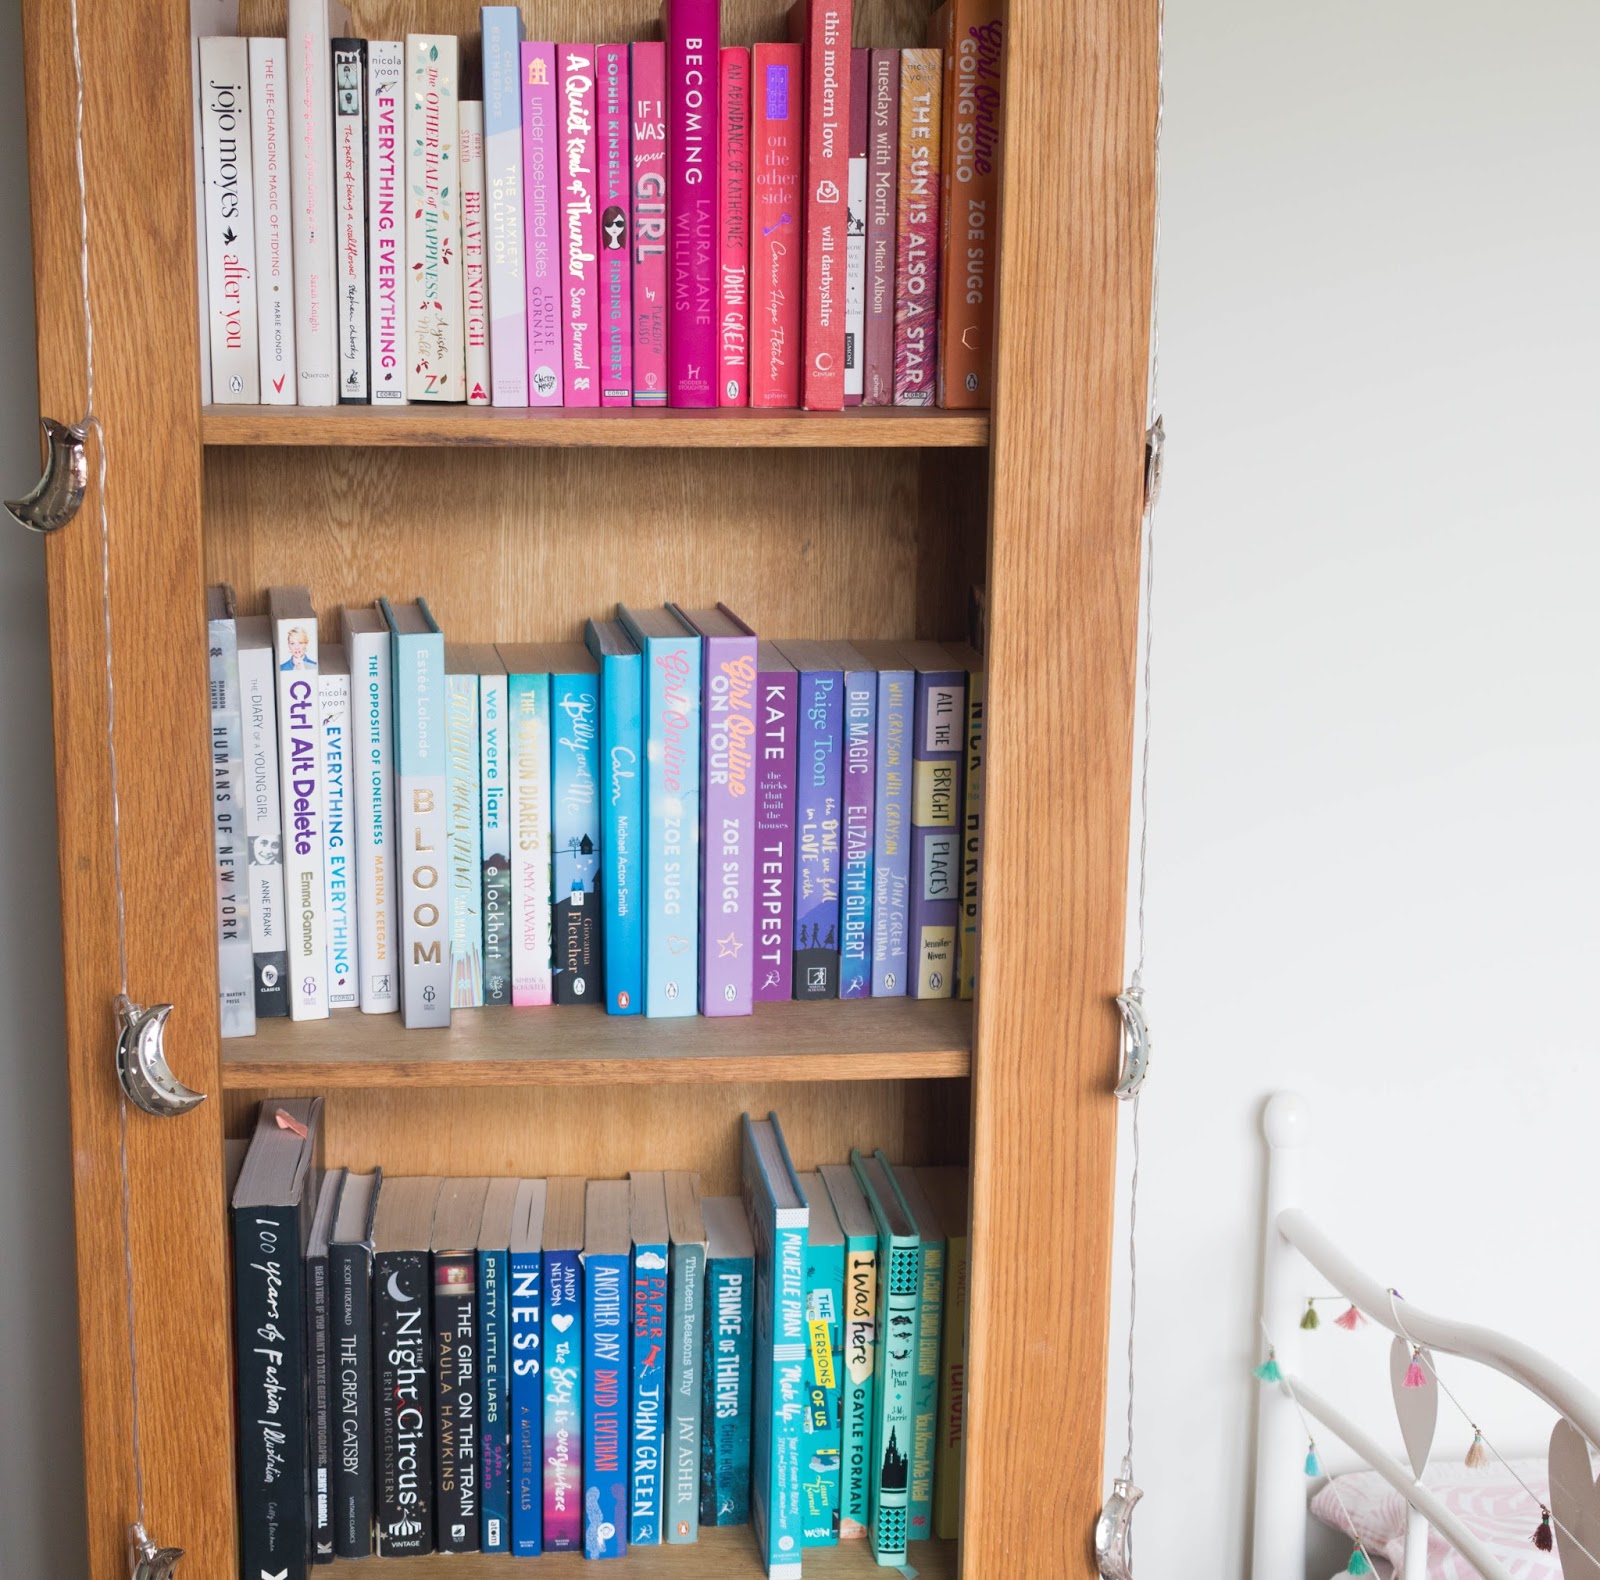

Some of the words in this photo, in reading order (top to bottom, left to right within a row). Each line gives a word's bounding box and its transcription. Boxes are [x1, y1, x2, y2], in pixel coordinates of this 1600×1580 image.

[824, 11, 839, 46] this
[265, 58, 273, 80] THE
[372, 55, 401, 65] nicola
[375, 68, 399, 77] yoon
[428, 67, 438, 87] The
[608, 53, 619, 114] SOPHIE
[823, 50, 837, 118] modern
[958, 39, 976, 118] GOING
[210, 80, 241, 131] jojo
[686, 38, 702, 185] BECOMING
[875, 61, 892, 126] tuesdays
[911, 92, 930, 138] THE
[266, 83, 275, 171] LIFE-CHANGING
[426, 92, 439, 148] OTHER
[531, 97, 545, 145] under
[823, 122, 838, 158] love
[379, 97, 394, 231] EVERYTHING,
[426, 152, 439, 196] HALF
[608, 121, 619, 199] KINSELLA
[876, 133, 890, 165] with
[910, 147, 928, 195] SUN
[957, 123, 974, 182] SOLO
[214, 138, 240, 218] moyes
[268, 174, 277, 211] MAGIC
[426, 196, 437, 208] of
[532, 147, 546, 238] rose-tainted
[875, 172, 890, 225] Morrie
[270, 214, 278, 229] OF
[465, 191, 482, 256] BRAVE
[696, 200, 710, 267] LAURA
[821, 226, 834, 251] will
[910, 203, 926, 223] IS
[968, 200, 985, 240] ZOE
[271, 232, 280, 276] TIDYING
[425, 211, 439, 298] HAPPINESS
[535, 241, 548, 277] skies
[675, 213, 690, 311] WILLIAMS
[875, 240, 886, 272] Mitch
[907, 233, 926, 293] ALSO
[967, 248, 983, 304] SUGG
[223, 254, 250, 306] after
[380, 239, 396, 369] EVERYTHING
[467, 264, 484, 347] ENOUGH
[611, 260, 620, 319] FINDING
[696, 274, 710, 325] JANE
[723, 264, 746, 304] JOHN
[819, 254, 834, 326] darbyshire
[874, 276, 886, 313] Albom
[217, 310, 243, 349] you
[274, 301, 282, 327] MARIE
[533, 287, 544, 354] GORNALL
[544, 295, 554, 345] LOUISE
[907, 302, 923, 317] A
[275, 330, 283, 362] KONDO
[611, 326, 622, 380] AUDREY
[723, 312, 744, 365] GREEN
[905, 327, 924, 383] STAR
[368, 655, 378, 677] THE
[289, 681, 313, 729] Ctrl
[369, 683, 380, 744] OPPOSITE
[486, 690, 499, 720] we
[711, 675, 728, 712] ON
[808, 678, 835, 729] Paige
[851, 691, 871, 718] BIG
[936, 692, 953, 715] ALL
[766, 686, 785, 759] KATE
[849, 722, 868, 774] MAGIC
[935, 723, 950, 746] THE
[213, 727, 231, 803] HUMANS
[291, 737, 313, 776] Alt
[372, 749, 381, 766] OF
[486, 727, 500, 780] were
[610, 746, 636, 805] Calm
[711, 721, 729, 784] TOUR
[813, 735, 833, 787] Toon
[293, 780, 316, 855] Delete
[373, 770, 383, 845] LONELINESS
[487, 787, 503, 829] liars
[932, 768, 951, 821] BRIGHT
[217, 814, 232, 834] OF
[617, 816, 628, 855] Michael
[722, 819, 740, 855] ZOE
[847, 806, 866, 890] ELIZABETH
[220, 846, 235, 886] NEW
[301, 871, 314, 907] Emma
[375, 856, 385, 907] MARINA
[523, 861, 535, 892] AMY
[618, 857, 628, 886] Acton
[722, 862, 738, 913] SUGG
[929, 841, 949, 894] PLACES
[221, 895, 238, 940] YORK
[261, 880, 271, 904] ANNE
[486, 866, 504, 958] e.lockhart
[618, 888, 629, 916] Smith
[762, 842, 782, 965] TEMPEST
[263, 907, 273, 937] FRANK
[302, 910, 315, 956] Gannon
[376, 911, 387, 960] KEEGAN
[524, 894, 536, 950] ALWARD
[567, 911, 583, 974] Fletcher
[583, 918, 592, 965] Giovanna
[846, 896, 866, 959] GILBERT
[486, 1258, 496, 1317] PRETTY
[684, 1257, 696, 1311] Thirteen
[782, 1233, 801, 1297] MICHELLE
[457, 1302, 471, 1335] THE
[594, 1266, 619, 1327] ANOTHER
[635, 1277, 648, 1337] TOWNS
[650, 1278, 664, 1339] PAPER
[718, 1274, 742, 1334] PRINCE
[783, 1300, 800, 1337] PHAN
[819, 1295, 832, 1318] THE
[487, 1323, 497, 1373] LITTLE
[513, 1272, 539, 1376] NESS
[594, 1333, 619, 1361] DAY
[683, 1315, 694, 1366] Reasons
[721, 1340, 736, 1353] OF
[341, 1335, 357, 1365] THE
[388, 1308, 425, 1401] Night
[440, 1332, 452, 1392] PAULA
[459, 1345, 472, 1386] GIRL
[815, 1324, 830, 1384] VERSIONS
[341, 1370, 358, 1415] GREAT
[459, 1393, 472, 1418] ON
[487, 1379, 497, 1422] LIARS
[594, 1370, 617, 1407] DAVID
[681, 1368, 693, 1395] Why
[716, 1355, 740, 1418] THIEVES
[811, 1390, 824, 1407] OF
[635, 1384, 659, 1441] JOHN
[677, 1416, 693, 1444] JAY
[815, 1411, 826, 1427] US
[851, 1389, 865, 1440] GAYLE
[342, 1419, 358, 1475] GATSBY
[397, 1407, 423, 1505] Circus
[442, 1406, 454, 1491] HAWKINS
[459, 1424, 473, 1456] THE
[595, 1412, 618, 1471] LEVITHAN
[460, 1464, 474, 1516] TRAIN
[633, 1447, 656, 1516] GREEN
[677, 1447, 692, 1504] ASHER
[850, 1445, 865, 1514] FORMAN
[490, 1522, 498, 1544] atom
